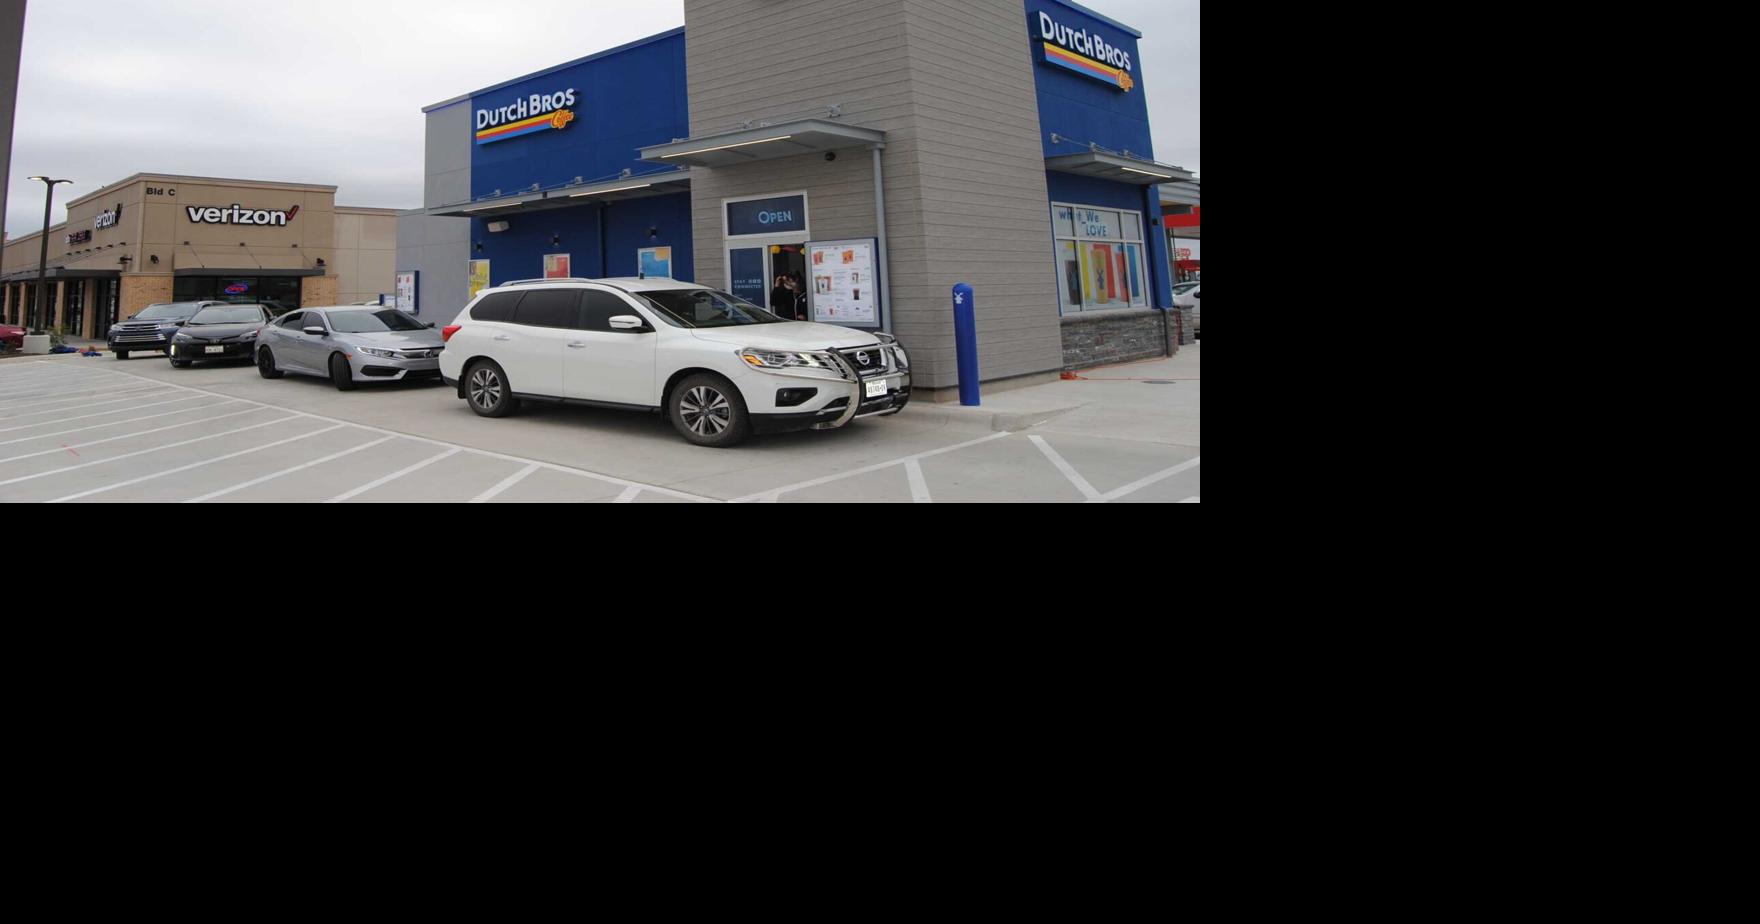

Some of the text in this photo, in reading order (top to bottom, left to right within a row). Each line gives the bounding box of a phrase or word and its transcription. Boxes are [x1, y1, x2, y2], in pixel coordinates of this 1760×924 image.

[1038, 10, 1132, 71] DUTCH BROS
[476, 88, 576, 130] DUTCH BROS
[168, 188, 176, 196] C
[187, 204, 287, 226] verizon
[758, 210, 793, 224] OPEN
[1086, 224, 1107, 237] LOVE
